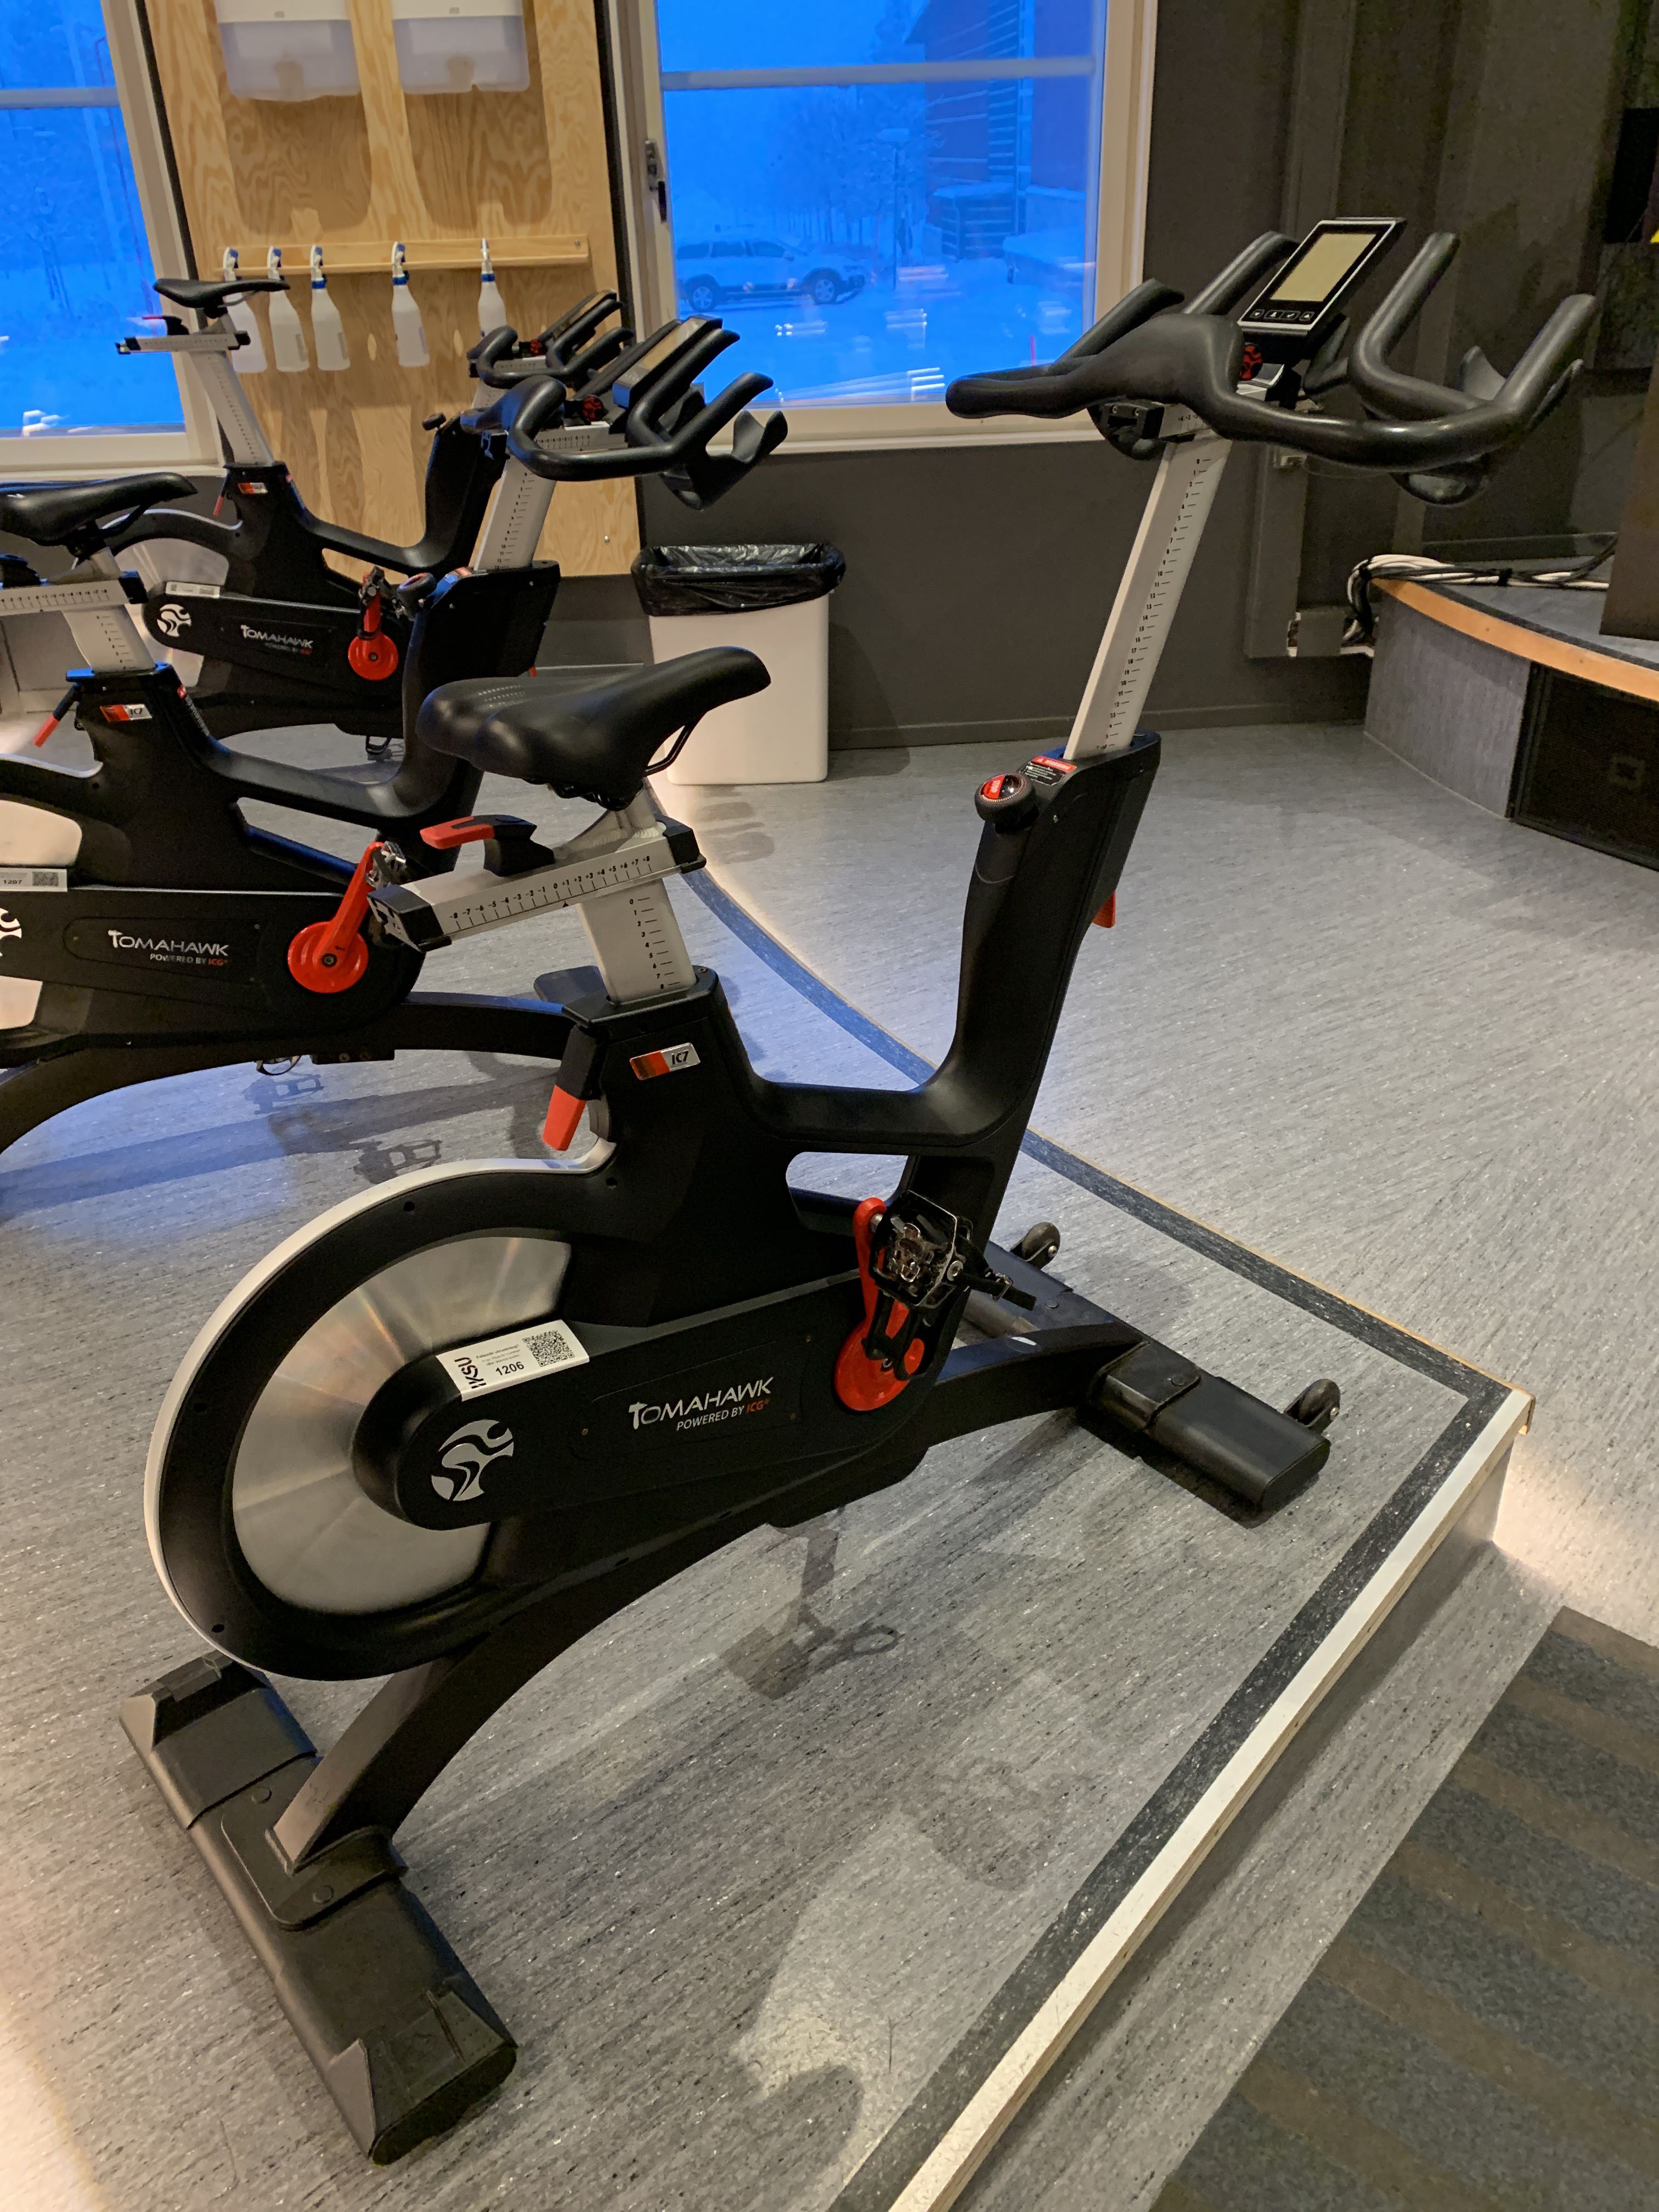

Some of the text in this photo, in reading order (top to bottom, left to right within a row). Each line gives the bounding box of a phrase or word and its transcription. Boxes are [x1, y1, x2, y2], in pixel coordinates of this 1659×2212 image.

[240, 624, 314, 648] TOMAHAWK
[108, 929, 229, 956] TOMAHAWK
[150, 953, 193, 963] POWERED
[672, 1050, 689, 1065] IC7
[454, 1357, 487, 1389] IKSU
[495, 1362, 524, 1376] 1206
[628, 1377, 774, 1430] TOMAHAWK
[676, 1410, 729, 1431] POWERED
[731, 1405, 745, 1418] BY
